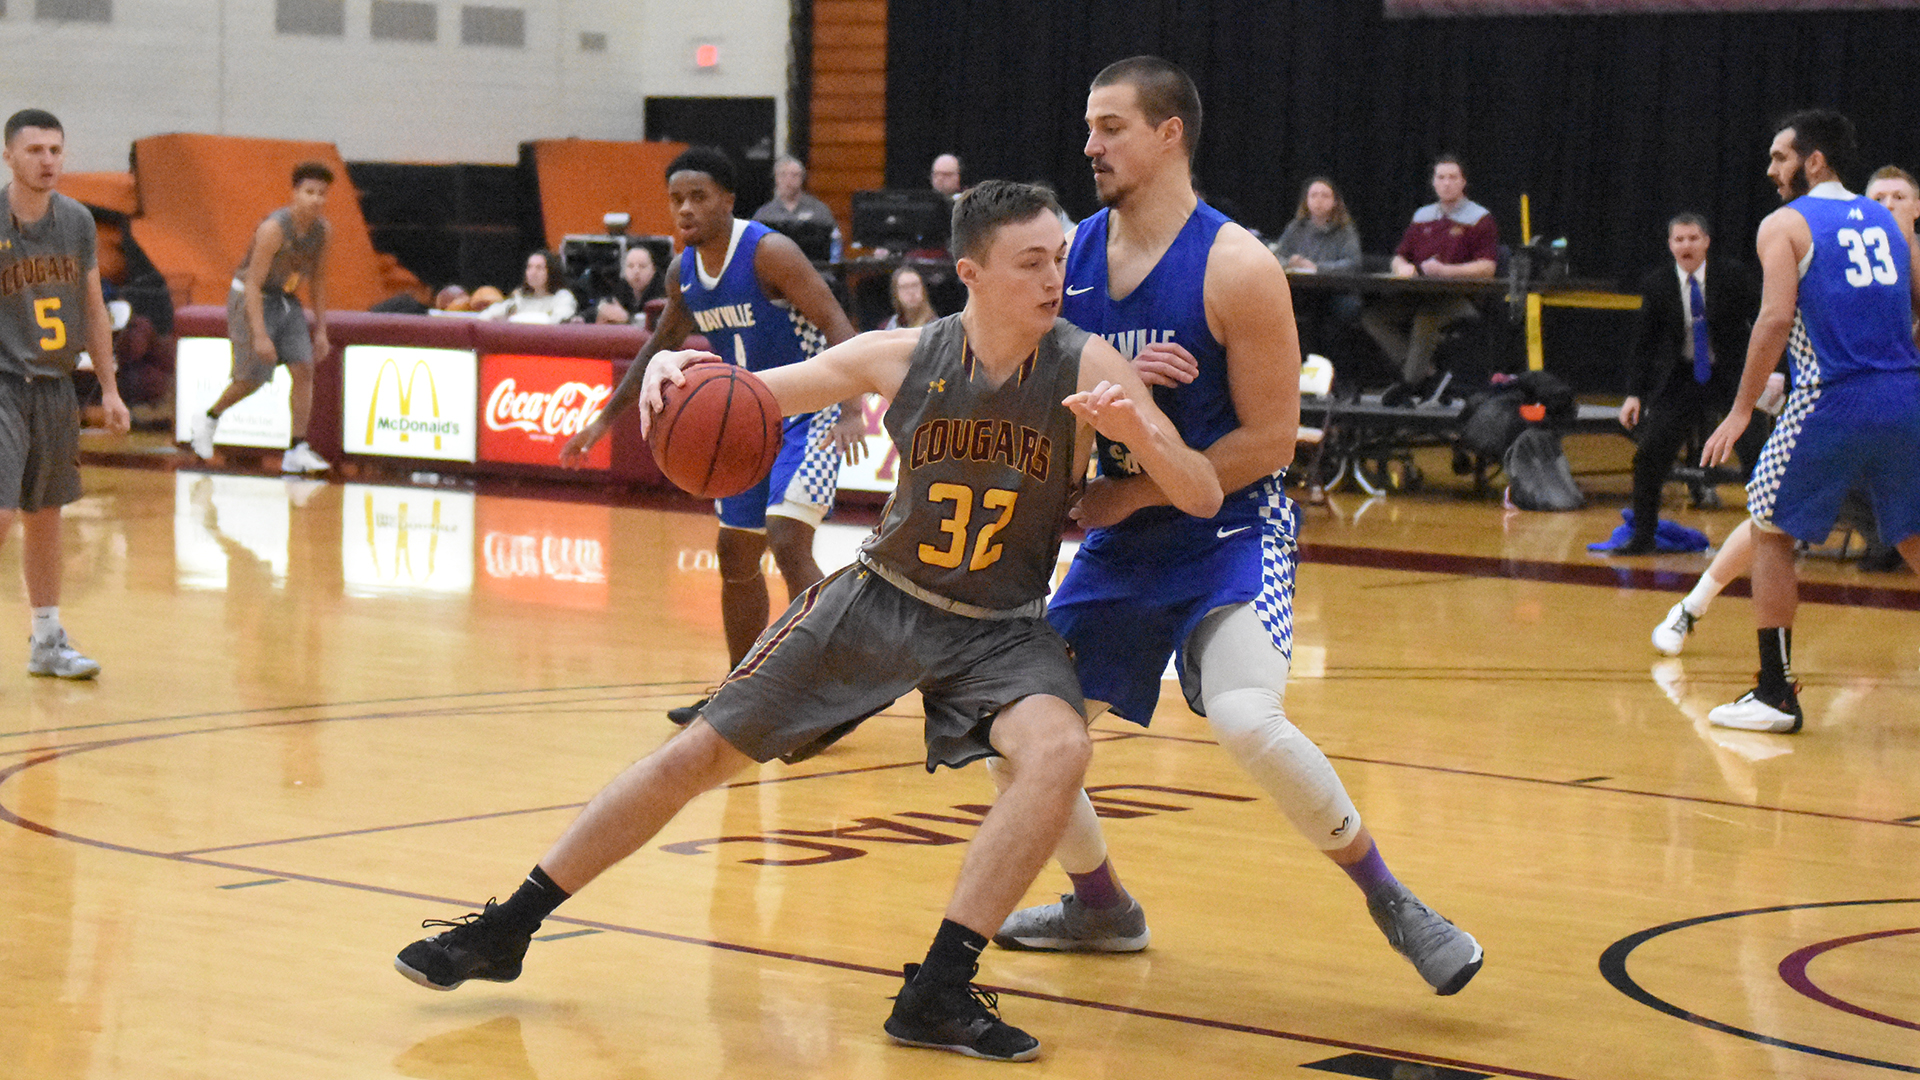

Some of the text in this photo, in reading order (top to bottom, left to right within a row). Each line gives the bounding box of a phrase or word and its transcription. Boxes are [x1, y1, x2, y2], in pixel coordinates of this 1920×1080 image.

[1, 255, 80, 297] COUGAR
[1837, 226, 1899, 288] 33
[33, 297, 67, 351] 5
[377, 416, 460, 436] McDonald's
[910, 418, 1052, 483] COUGARS
[917, 482, 1019, 572] 32
